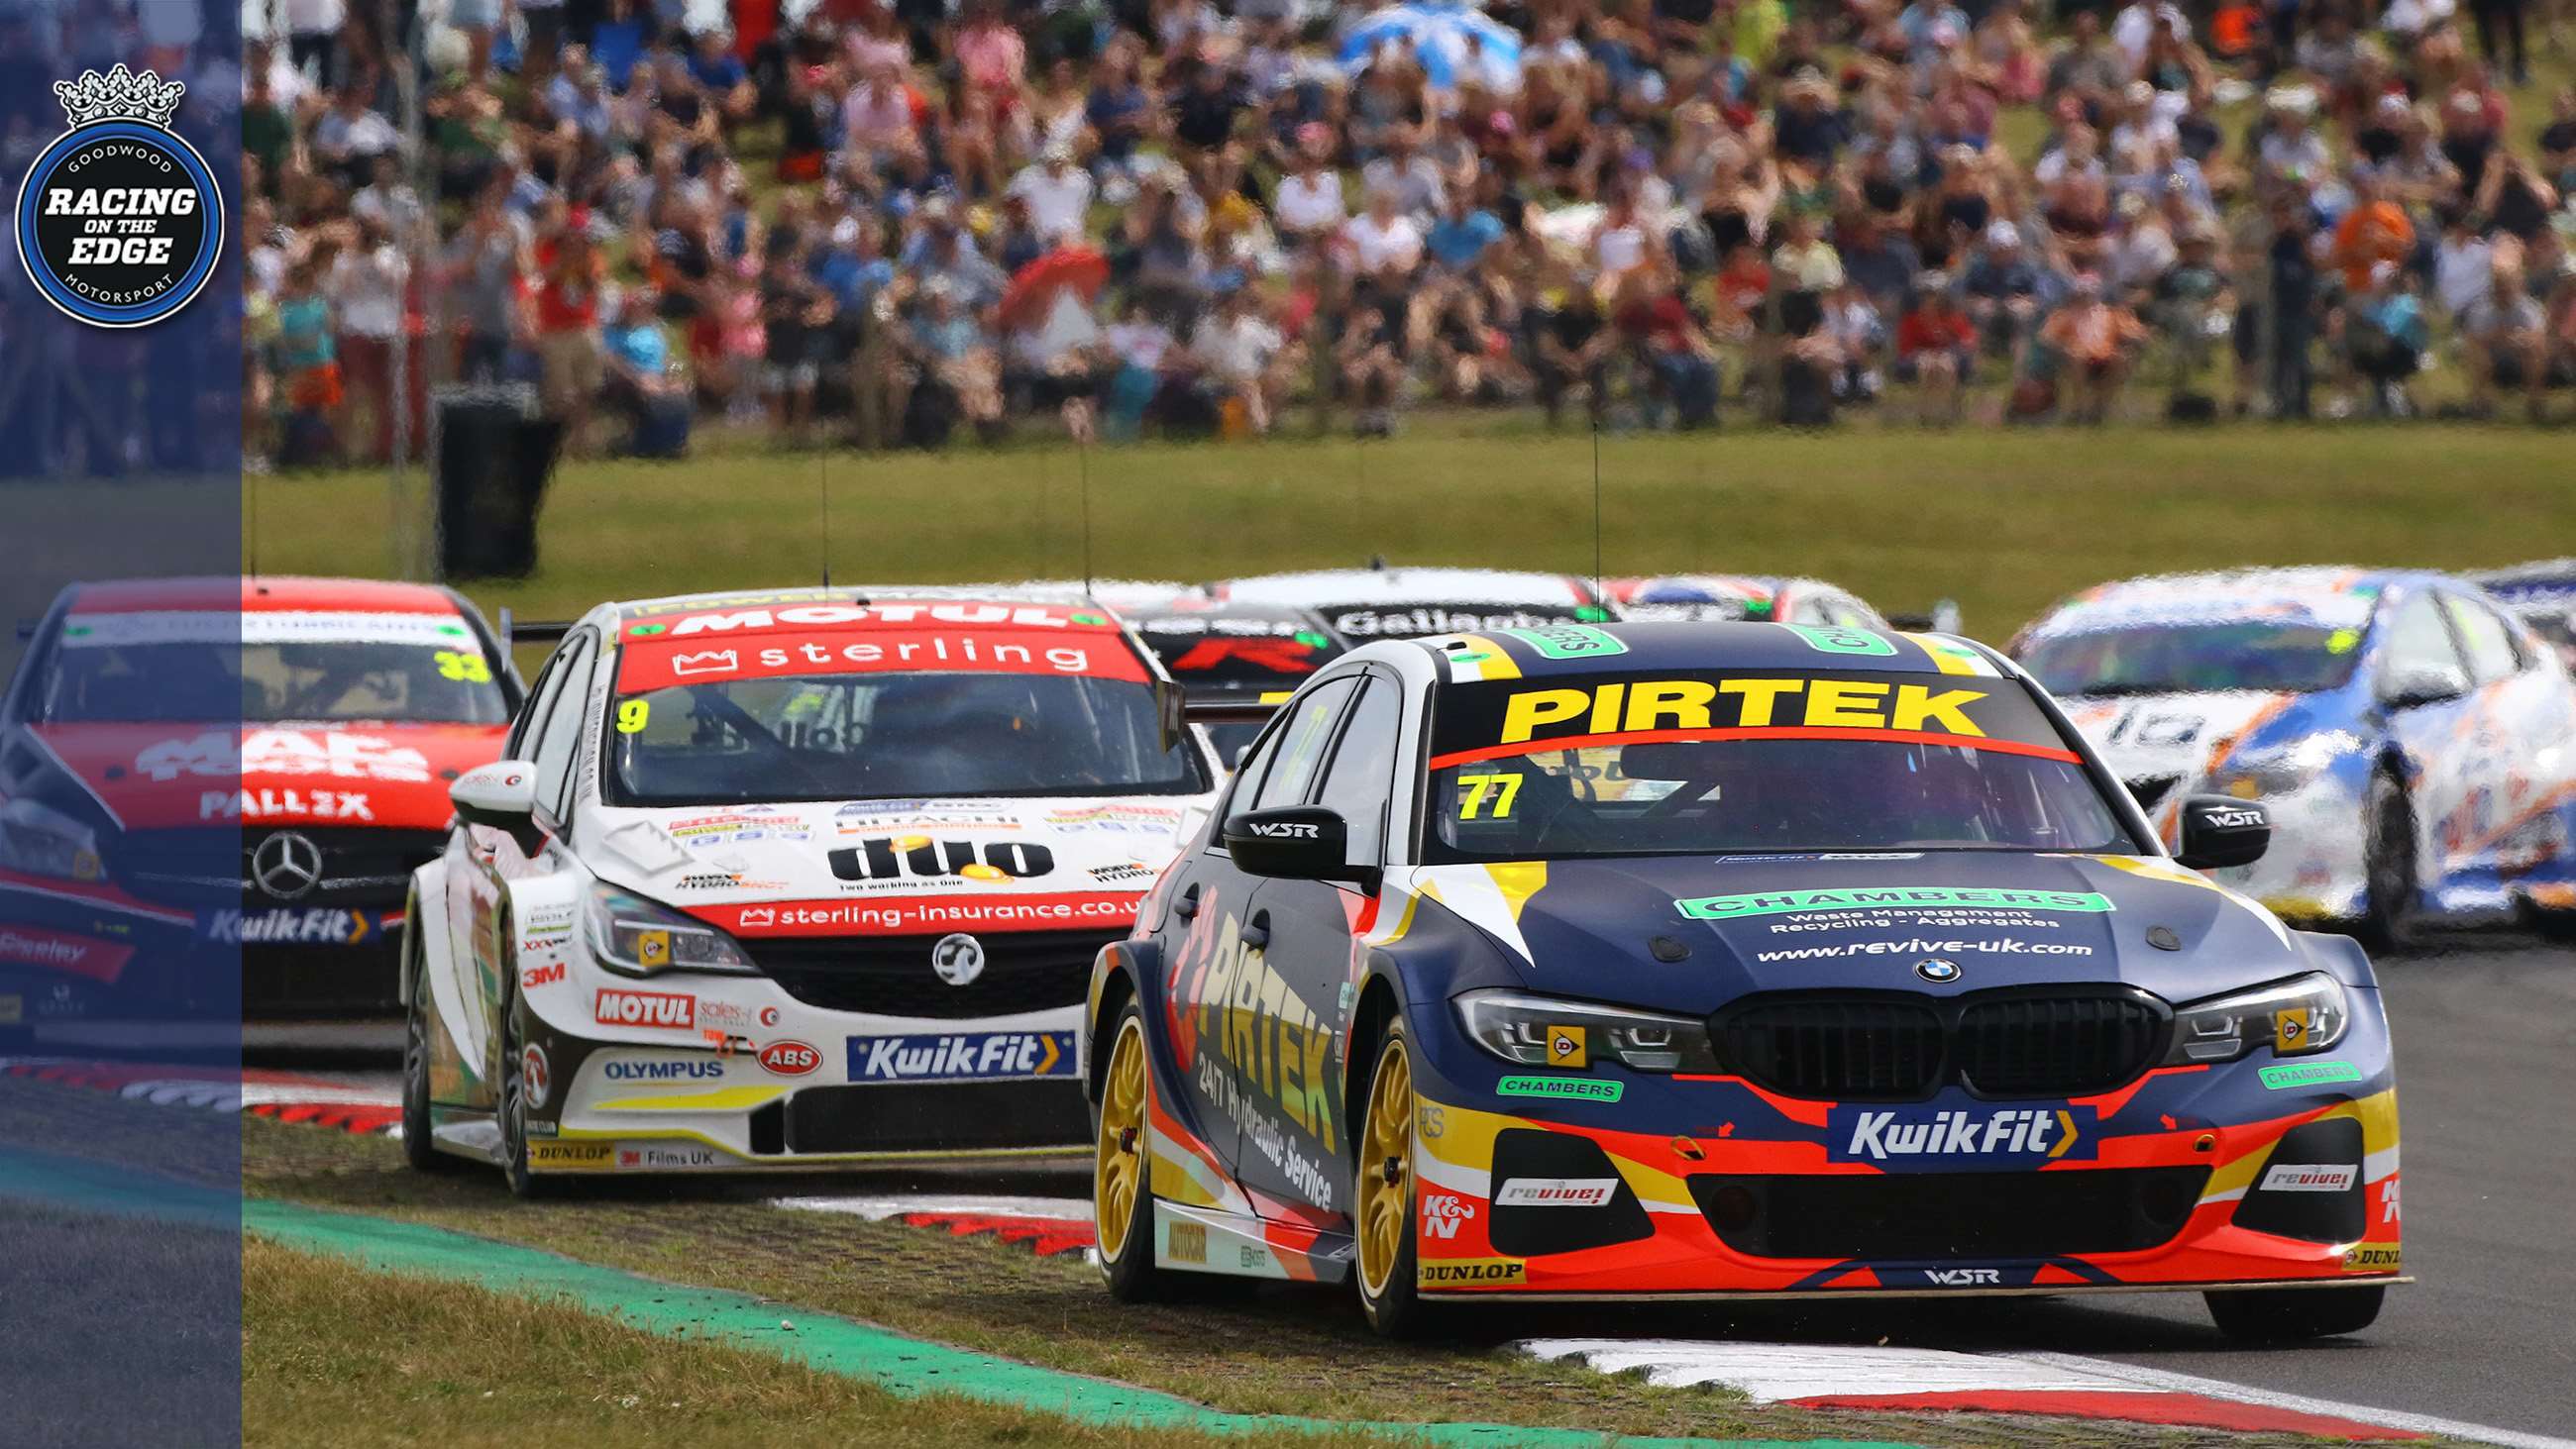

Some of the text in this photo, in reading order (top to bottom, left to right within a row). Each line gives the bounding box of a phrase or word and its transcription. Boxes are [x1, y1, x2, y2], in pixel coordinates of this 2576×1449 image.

[670, 604, 1073, 635] MOTUL
[759, 637, 1088, 672] sterling
[434, 651, 492, 682] 33
[616, 699, 650, 734] 9
[1500, 678, 1988, 744] PIRTEK
[1457, 774, 1523, 819] 77
[2204, 811, 2265, 827] WSR
[1249, 823, 1319, 838] WSR
[1703, 891, 2089, 912] CHAMBERS
[780, 900, 1140, 927] sterling-insurance.co.u
[1786, 908, 2032, 922] Waste Management
[1771, 917, 1890, 934] Recycling
[1917, 916, 2060, 928] Aggregates
[1757, 938, 2093, 962] www.revive-uk.com
[523, 963, 564, 987] 3M
[597, 993, 691, 1025] MOTUL
[1199, 911, 1336, 1156] PIRTEK
[768, 1050, 812, 1067] ABS
[605, 1061, 723, 1080] OLYMPUS
[2267, 1065, 2355, 1085] CHAMBERS
[1506, 1080, 1615, 1096] CHAMBERS
[539, 1147, 610, 1160] DUNLOP
[1227, 1076, 1285, 1170] Hydraulic
[1285, 1136, 1333, 1213] Service
[621, 1150, 714, 1165] 3M Films UK
[1426, 1264, 1523, 1280] DUNLOP
[1924, 1269, 2001, 1285] WSR
